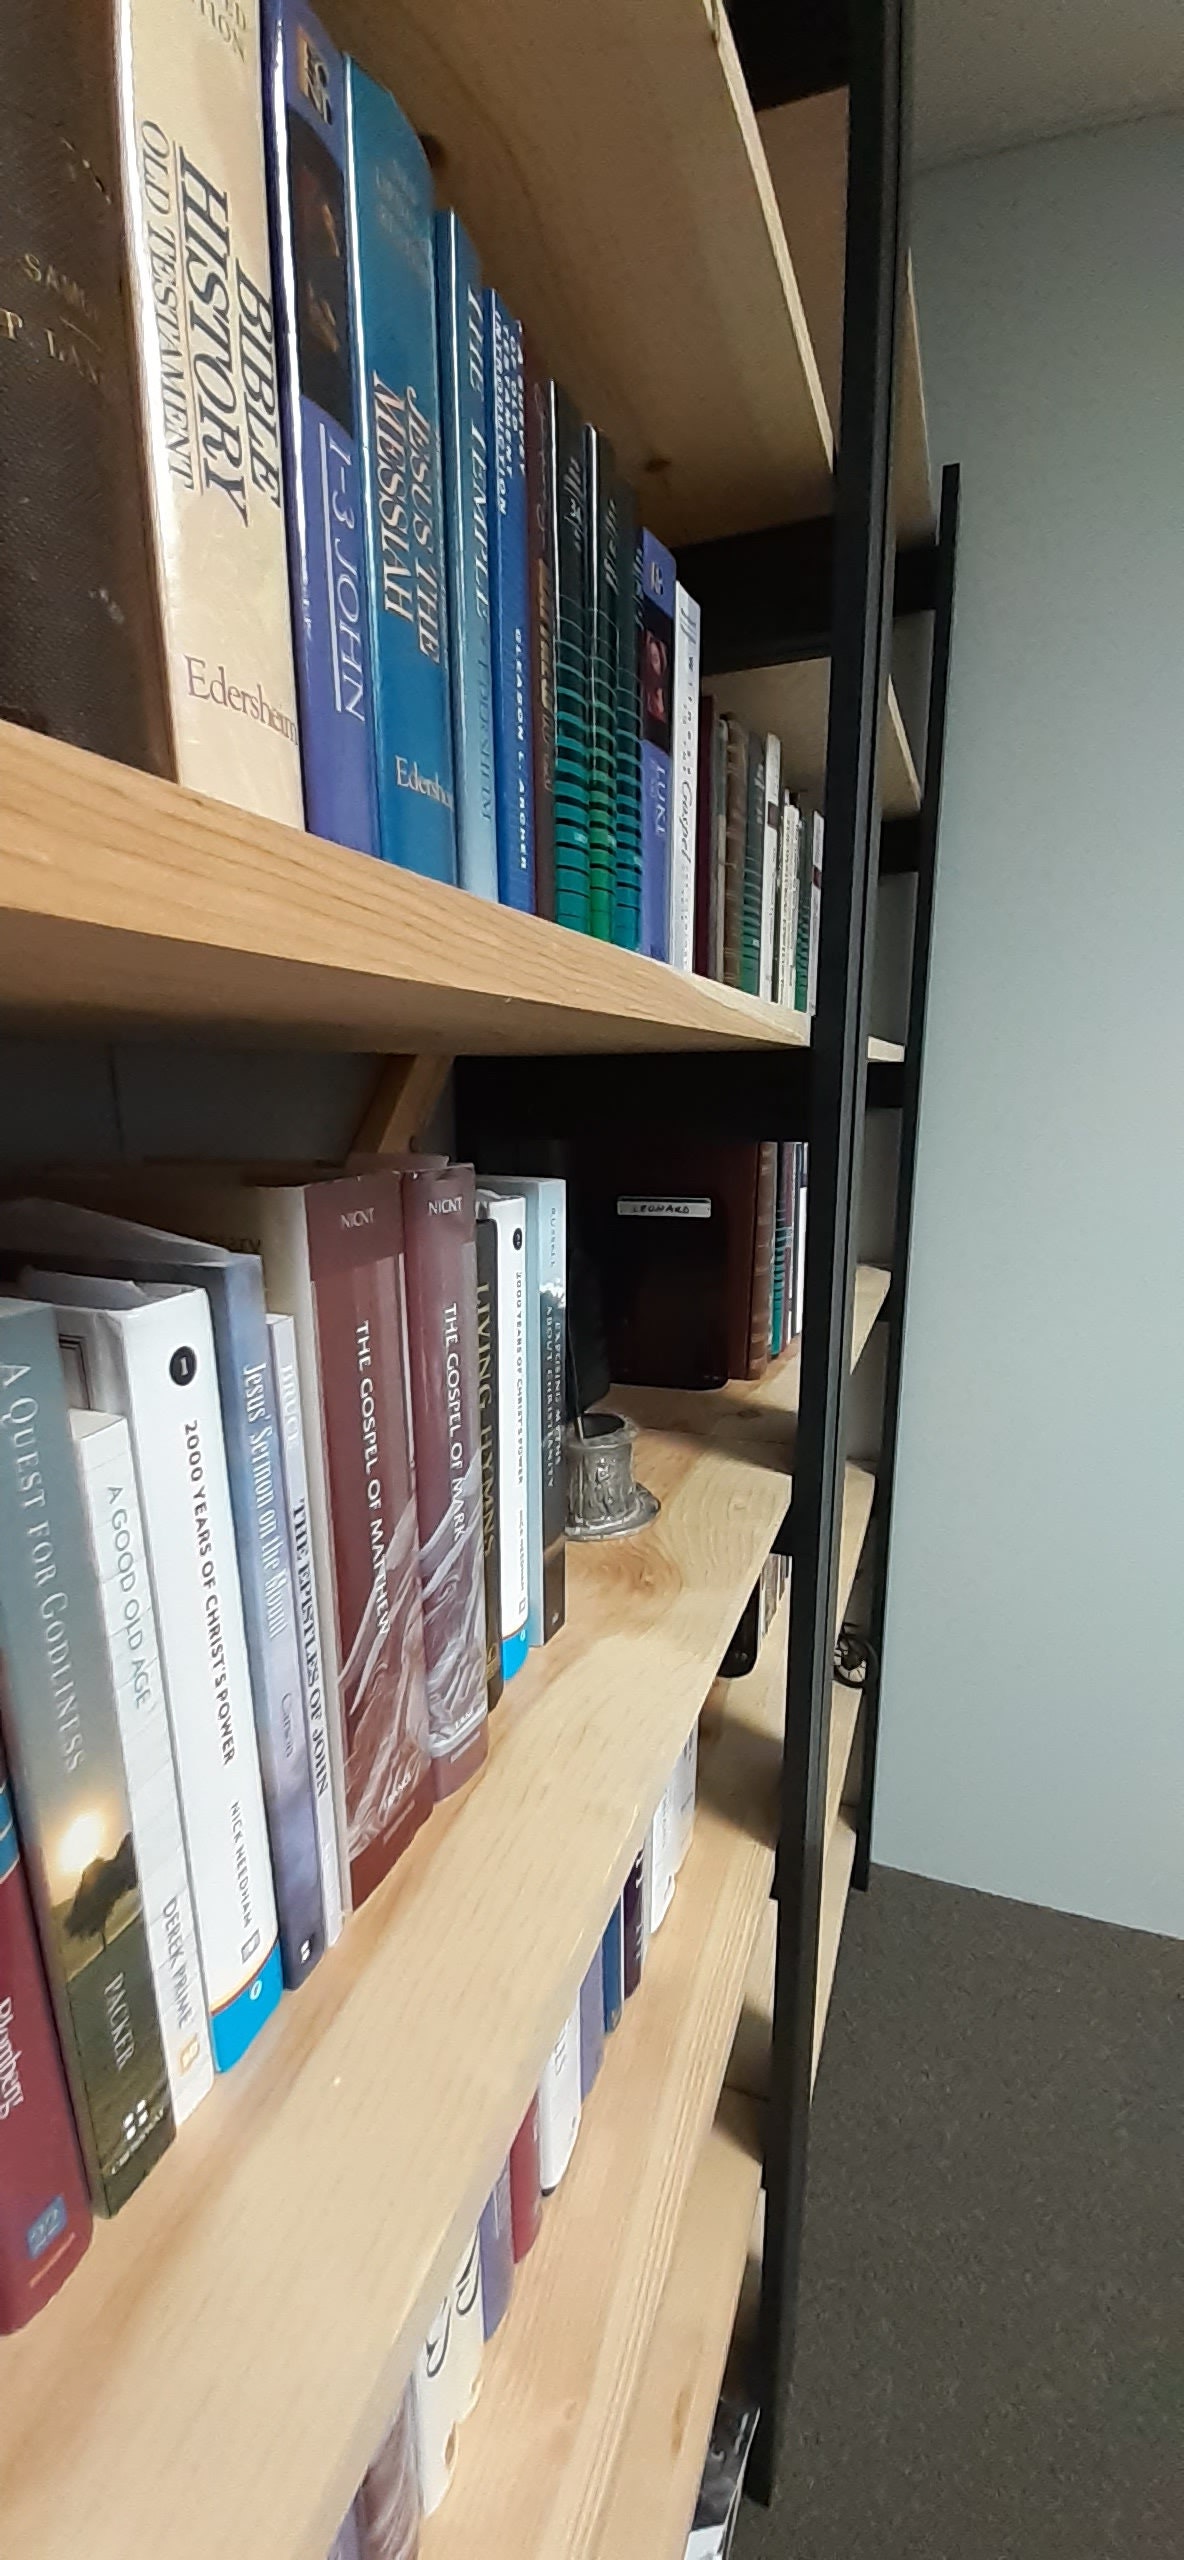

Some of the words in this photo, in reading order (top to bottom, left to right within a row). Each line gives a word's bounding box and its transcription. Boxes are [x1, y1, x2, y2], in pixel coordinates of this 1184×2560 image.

[141, 120, 170, 215] OLD
[147, 221, 194, 490] TESTAMENT
[180, 146, 248, 527] HISTORY
[236, 258, 281, 507] BIBLE
[329, 438, 354, 531] 1-3
[372, 370, 414, 622] MESSIAH
[405, 386, 433, 555] JESUS
[334, 538, 365, 722] JOHN
[415, 557, 440, 664] THE
[355, 1320, 374, 1375] THE
[443, 1302, 459, 1346] THE
[476, 1284, 491, 1409] LIVING
[360, 1377, 380, 1474] GOSPEL
[445, 1348, 461, 1438] GOSPEL
[1, 1396, 46, 1510] QUEST
[184, 1420, 200, 1482] 2000
[248, 1428, 273, 1507] Sermon
[449, 1440, 463, 1476] OF
[107, 1486, 123, 1506] A
[194, 1489, 213, 1556] YEARS
[258, 1509, 277, 1534] on
[367, 1477, 382, 1518] OF
[452, 1477, 464, 1541] MARK
[480, 1425, 495, 1555] HYMNS
[28, 1517, 56, 1587] FOR
[110, 1510, 136, 1591] GOOD
[260, 1535, 283, 1572] the
[291, 1497, 306, 1561] THE
[202, 1560, 216, 1589] OF
[371, 1519, 391, 1635] MATTHEW
[122, 1598, 144, 1651] OLD
[205, 1593, 228, 1687] CHRIST'S
[296, 1563, 319, 1685] EPISTLES
[40, 1591, 85, 1771] GODLINESS
[132, 1656, 152, 1710] AGE
[309, 1687, 322, 1721] OF
[216, 1690, 234, 1766] POWER
[312, 1728, 329, 1798] JOHN
[230, 1800, 244, 1851] NICK
[236, 1853, 253, 1929] NEEDHAM
[162, 1897, 183, 1964] DEREK
[104, 1970, 137, 2073] PACKER
[170, 1964, 192, 2029] PRIME
